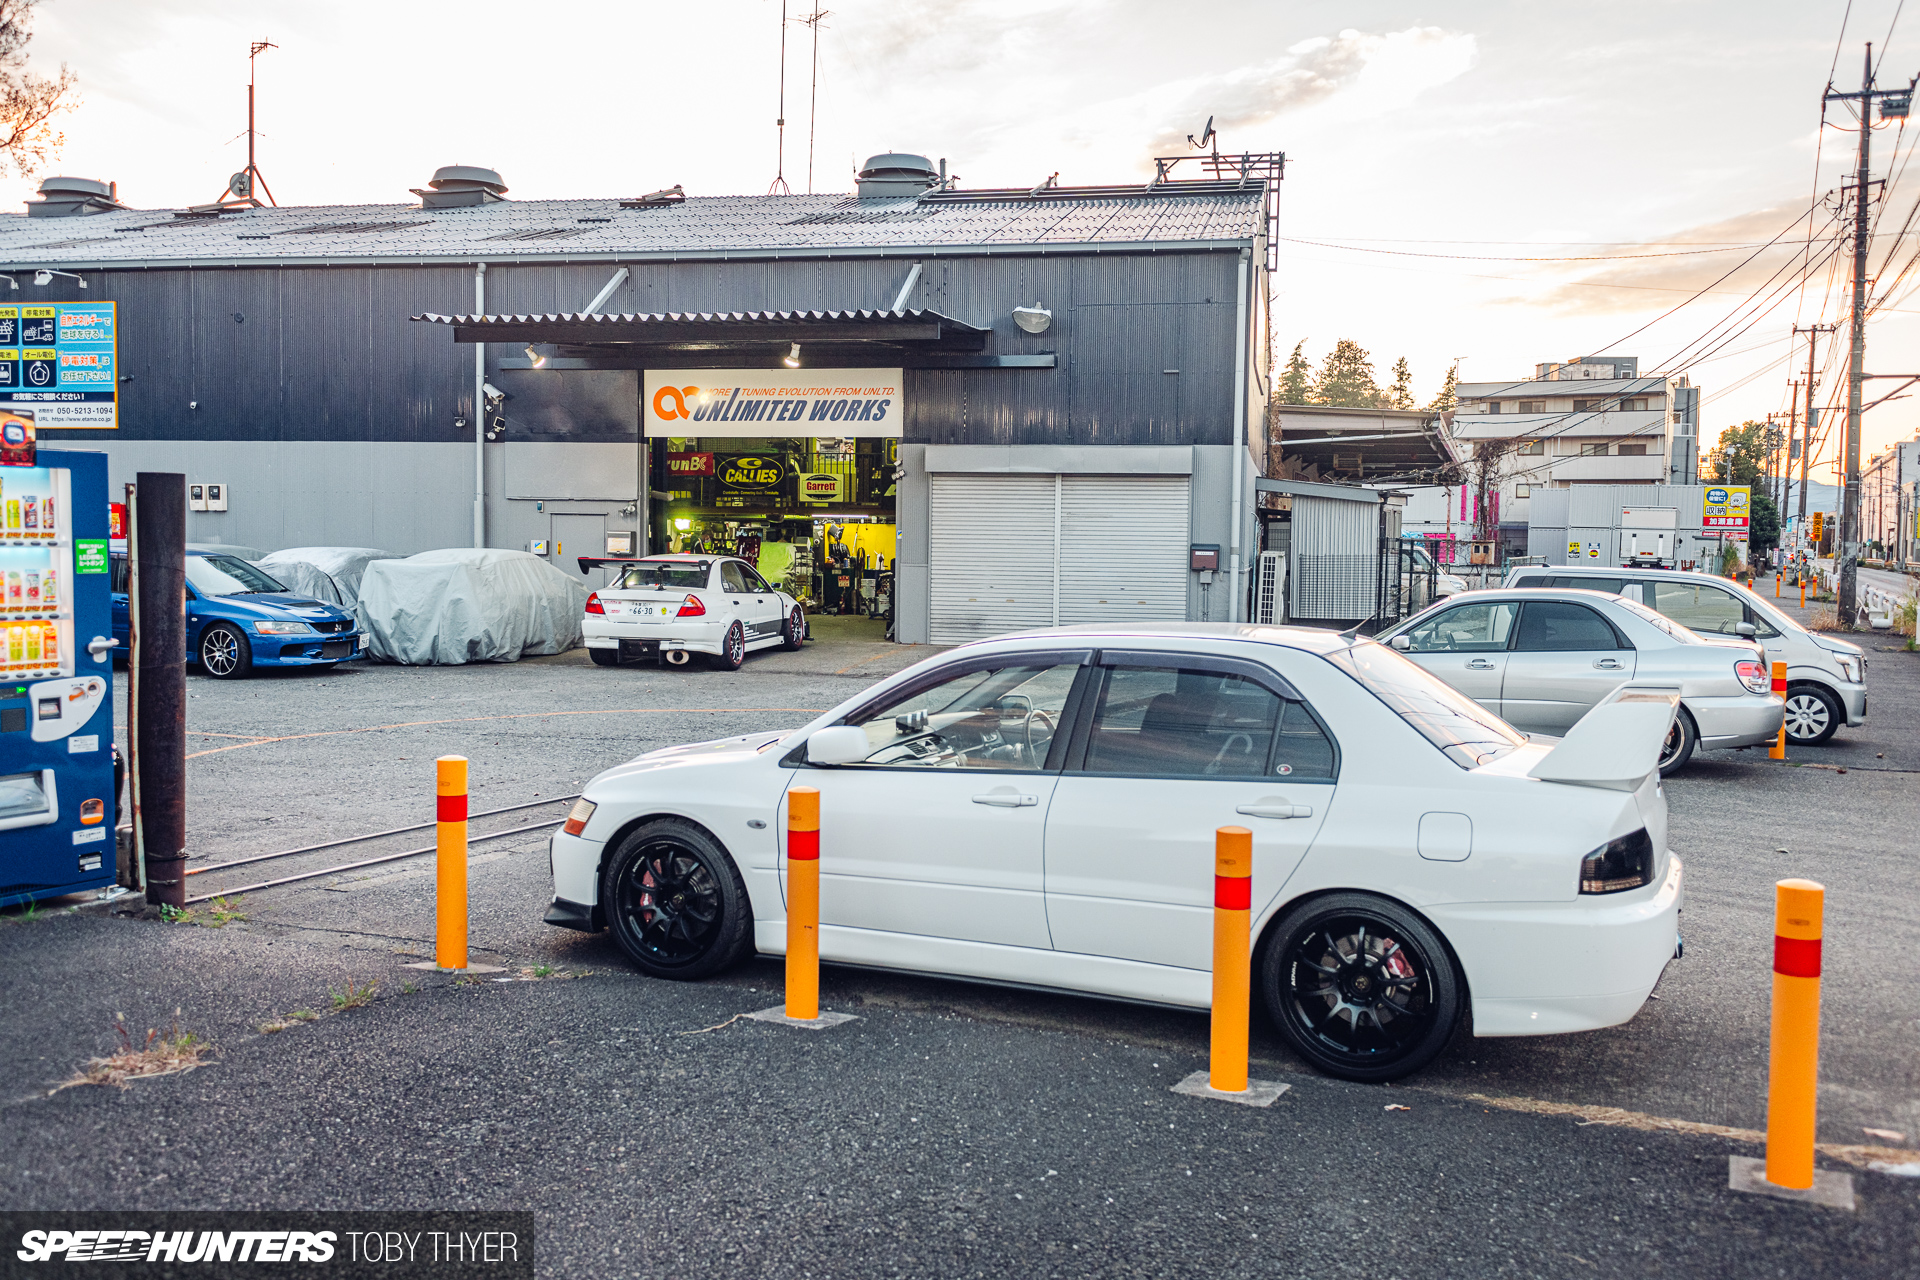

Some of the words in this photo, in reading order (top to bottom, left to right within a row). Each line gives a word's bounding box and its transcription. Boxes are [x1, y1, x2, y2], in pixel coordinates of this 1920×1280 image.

[26, 309, 51, 317] 停電対策
[741, 388, 776, 396] TUNING
[778, 387, 832, 396] EVOLUTION
[833, 387, 862, 396] FROM
[863, 387, 895, 396] UNLTD.
[693, 388, 807, 421] UNLIMITED
[808, 399, 891, 421] WORKS
[725, 469, 778, 483] CALLIES
[806, 481, 836, 491] Garrett
